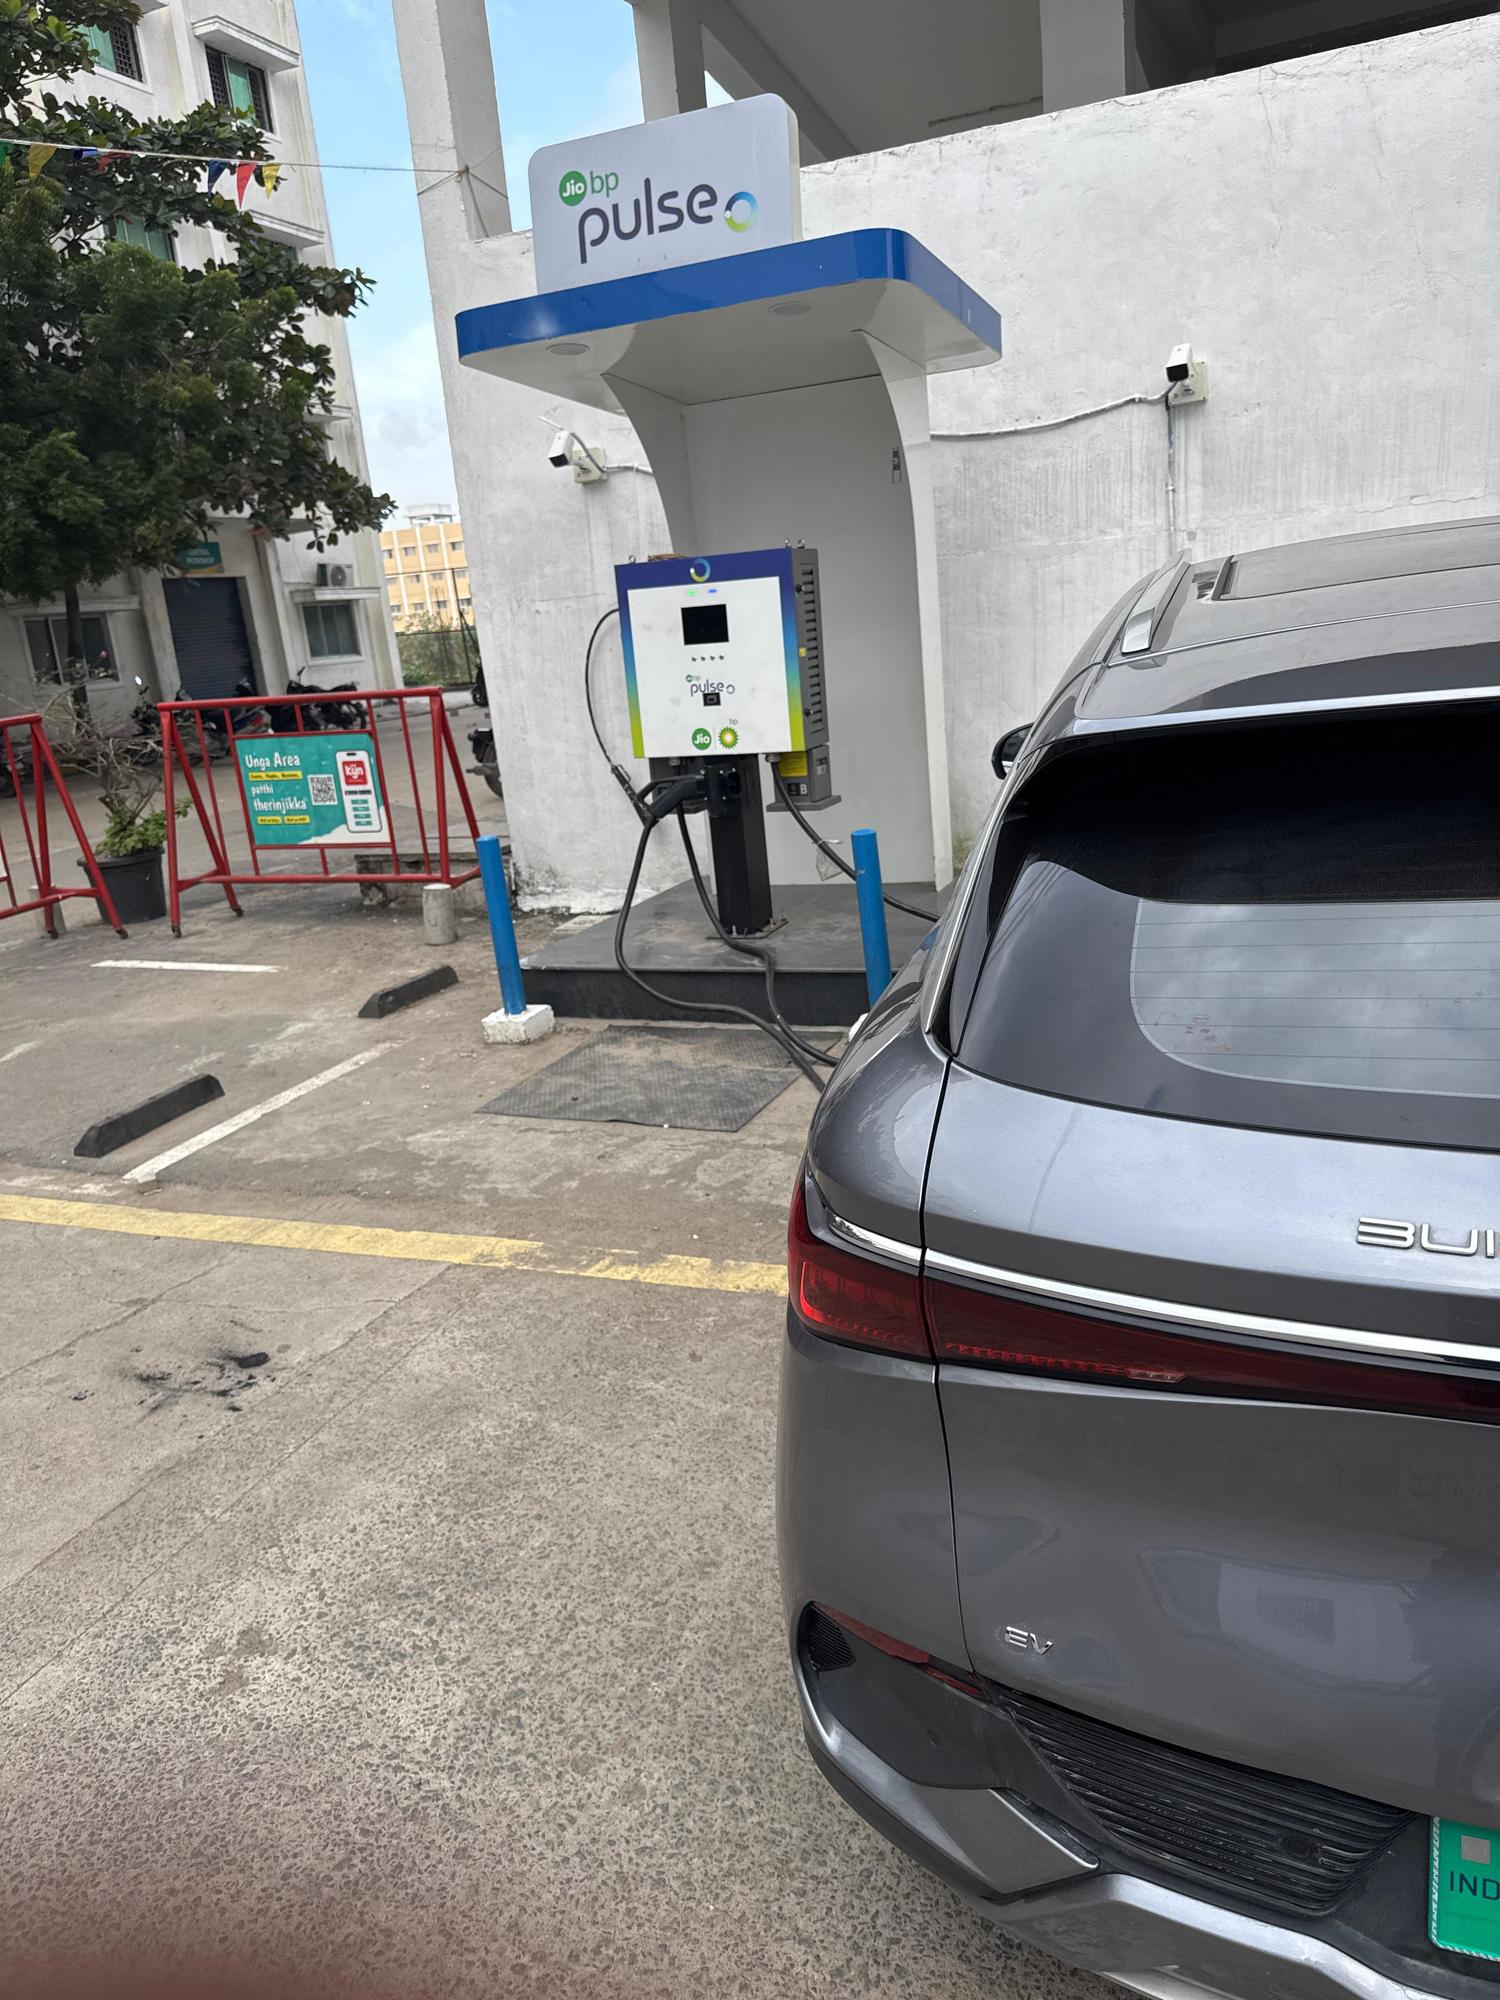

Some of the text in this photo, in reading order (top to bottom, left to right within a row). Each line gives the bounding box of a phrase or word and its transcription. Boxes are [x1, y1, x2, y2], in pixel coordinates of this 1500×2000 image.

[562, 170, 619, 198] Jio bp
[578, 177, 719, 265] pulse
[690, 679, 725, 697] pulse
[693, 733, 710, 745] Jio
[245, 752, 300, 771] Unga Area
[1005, 1626, 1054, 1655] EV
[1449, 1871, 1500, 1901] IND
